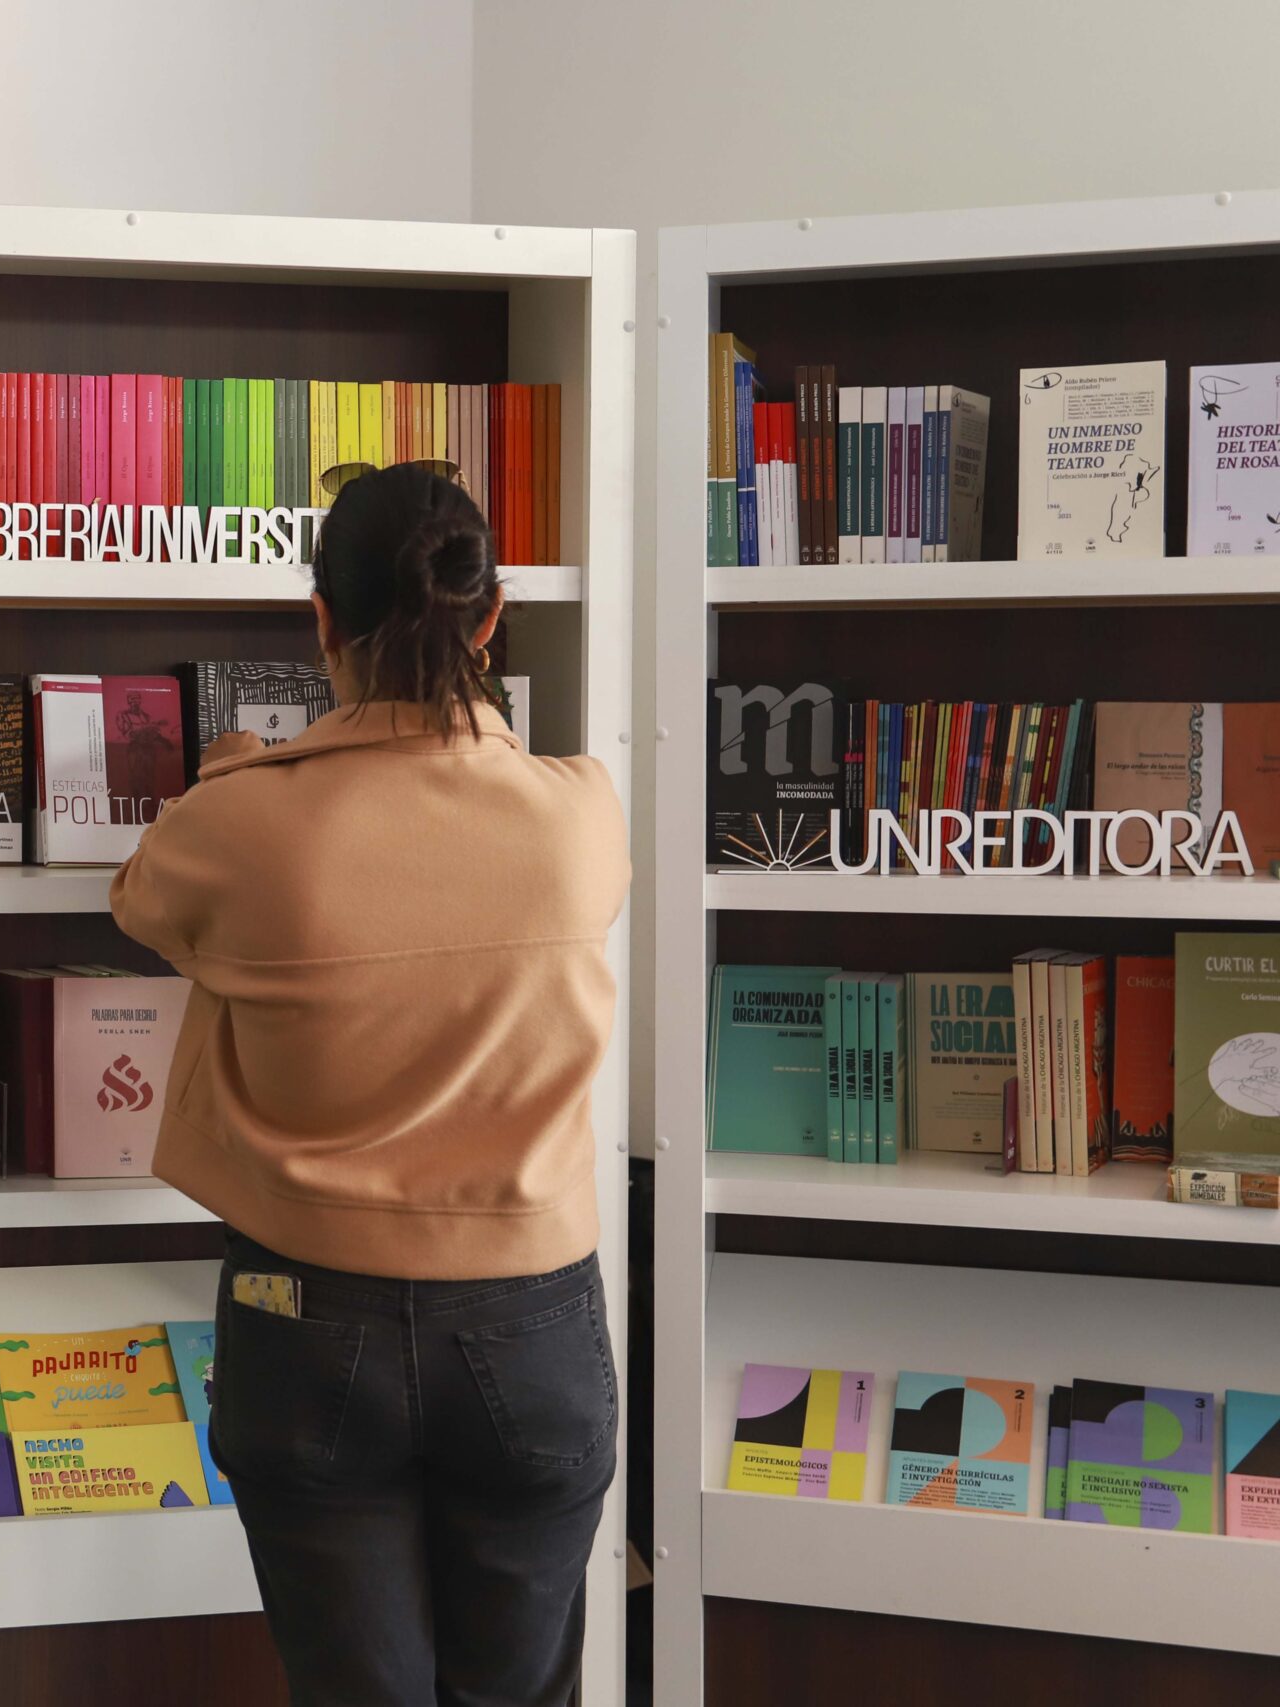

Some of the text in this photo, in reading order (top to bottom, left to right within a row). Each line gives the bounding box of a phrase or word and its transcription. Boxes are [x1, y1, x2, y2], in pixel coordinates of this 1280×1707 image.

[1047, 422, 1142, 439] UN INMENSO
[1047, 439, 1135, 455] HOMBRE DE
[1216, 441, 1246, 454] DEL
[1047, 456, 1104, 470] TEATRO
[1216, 457, 1237, 470] EN
[52, 779, 105, 793] ESTÉTICAS
[776, 781, 835, 791] la masculinidad
[776, 791, 834, 800] INCOMODADA
[1205, 956, 1278, 973] CURTIR EL
[733, 990, 824, 1008] LA COMUNIDAD
[931, 984, 1016, 1017] LA ERA
[91, 1008, 119, 1022] PALABRAS
[119, 1008, 134, 1021] PARA
[732, 1007, 823, 1024] ORGANIZADA
[1190, 1182, 1226, 1192] EXPEDICIÓN
[1190, 1191, 1225, 1201] HUMEDALES
[32, 1351, 137, 1377] PAJARITO
[856, 1380, 865, 1390] 1
[51, 1379, 128, 1409] puede
[1015, 1389, 1025, 1399] 2
[1194, 1398, 1205, 1409] 3
[744, 1455, 828, 1470] EPISTEMOLÓGICOS
[902, 1464, 939, 1474] GÉNERO
[955, 1469, 1014, 1482] CURRÍCULAS
[909, 1473, 982, 1487] INVESTIGACIÓN
[1082, 1474, 1189, 1493] LENGUAJE NO SEXISTA
[1089, 1484, 1141, 1496] INCLUSIVO
